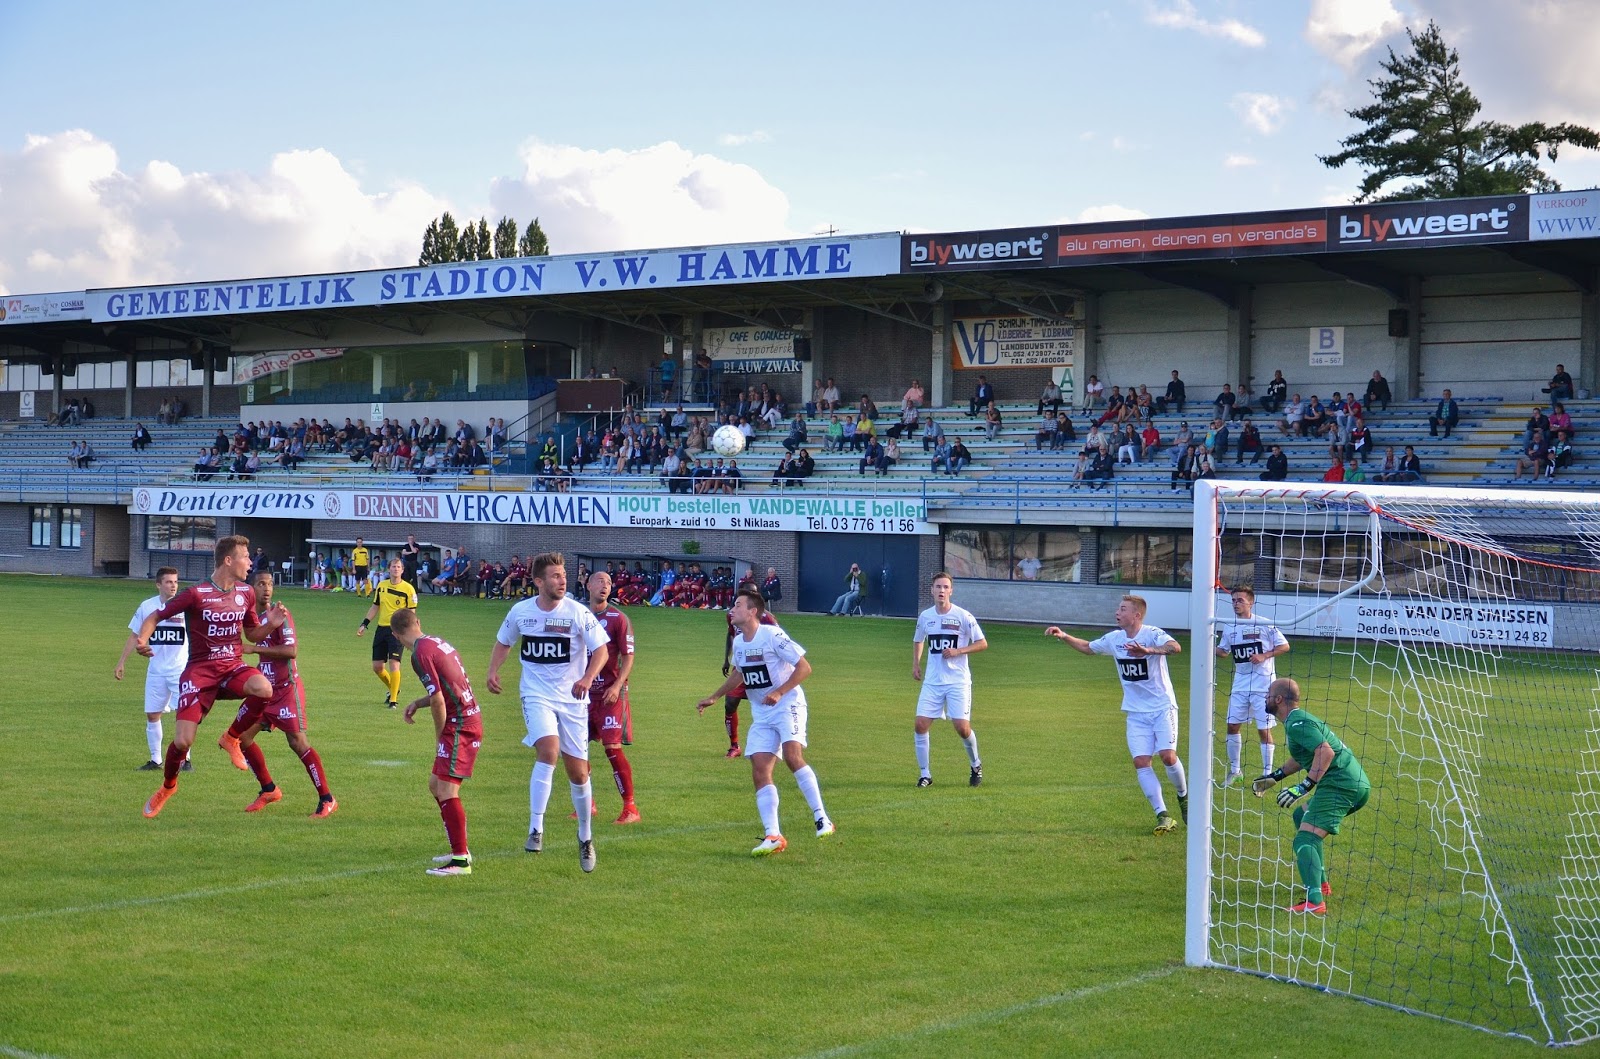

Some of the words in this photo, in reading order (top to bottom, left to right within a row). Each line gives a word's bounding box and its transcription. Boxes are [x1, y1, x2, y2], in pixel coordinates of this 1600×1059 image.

[1536, 198, 1588, 209] VERKOOP
[1339, 208, 1508, 242] blyweert
[1066, 239, 1087, 251] alu
[1092, 237, 1145, 250] ramen,
[1152, 233, 1206, 247] deuren
[1212, 231, 1231, 243] en
[1238, 225, 1317, 242] veranda's
[910, 236, 1043, 265] blyweert
[106, 277, 356, 318] GEMEENTELIJK
[380, 263, 546, 300] STADION
[676, 243, 852, 282] HAMME
[729, 331, 749, 343] CAFE
[753, 329, 803, 342] GOALKEEP
[1319, 328, 1335, 350] B
[735, 343, 795, 358] Supportersk
[158, 491, 315, 516] Dentergems
[357, 496, 436, 518] DRANKEN
[445, 495, 611, 524] VERCAMMEN
[618, 497, 662, 512] HOUT
[667, 498, 741, 514] bestellen
[748, 499, 866, 516] VANDEWALLE
[630, 516, 671, 528] Europark
[681, 517, 701, 527] zuid
[704, 517, 716, 527] 10
[730, 517, 741, 527] St
[744, 518, 780, 528] Niklaas
[806, 517, 827, 530] Tel.
[852, 518, 874, 531] 776
[881, 519, 894, 532] 11
[899, 519, 915, 532] 56
[202, 608, 246, 622] Record
[1358, 605, 1398, 619] Garage
[1405, 605, 1437, 619] VAN
[1441, 607, 1473, 621] DER
[1477, 608, 1548, 624] SMISSEN
[149, 631, 183, 642] JURL
[207, 623, 239, 637] Bank
[1357, 622, 1440, 636] Dendermonde
[1471, 629, 1493, 640] 052
[1497, 629, 1510, 640] 21
[1515, 630, 1529, 641] 24
[1532, 631, 1548, 642] 82
[522, 642, 567, 658] JURL
[181, 680, 196, 692] DL
[743, 671, 769, 686] URL
[605, 716, 619, 725] DL
